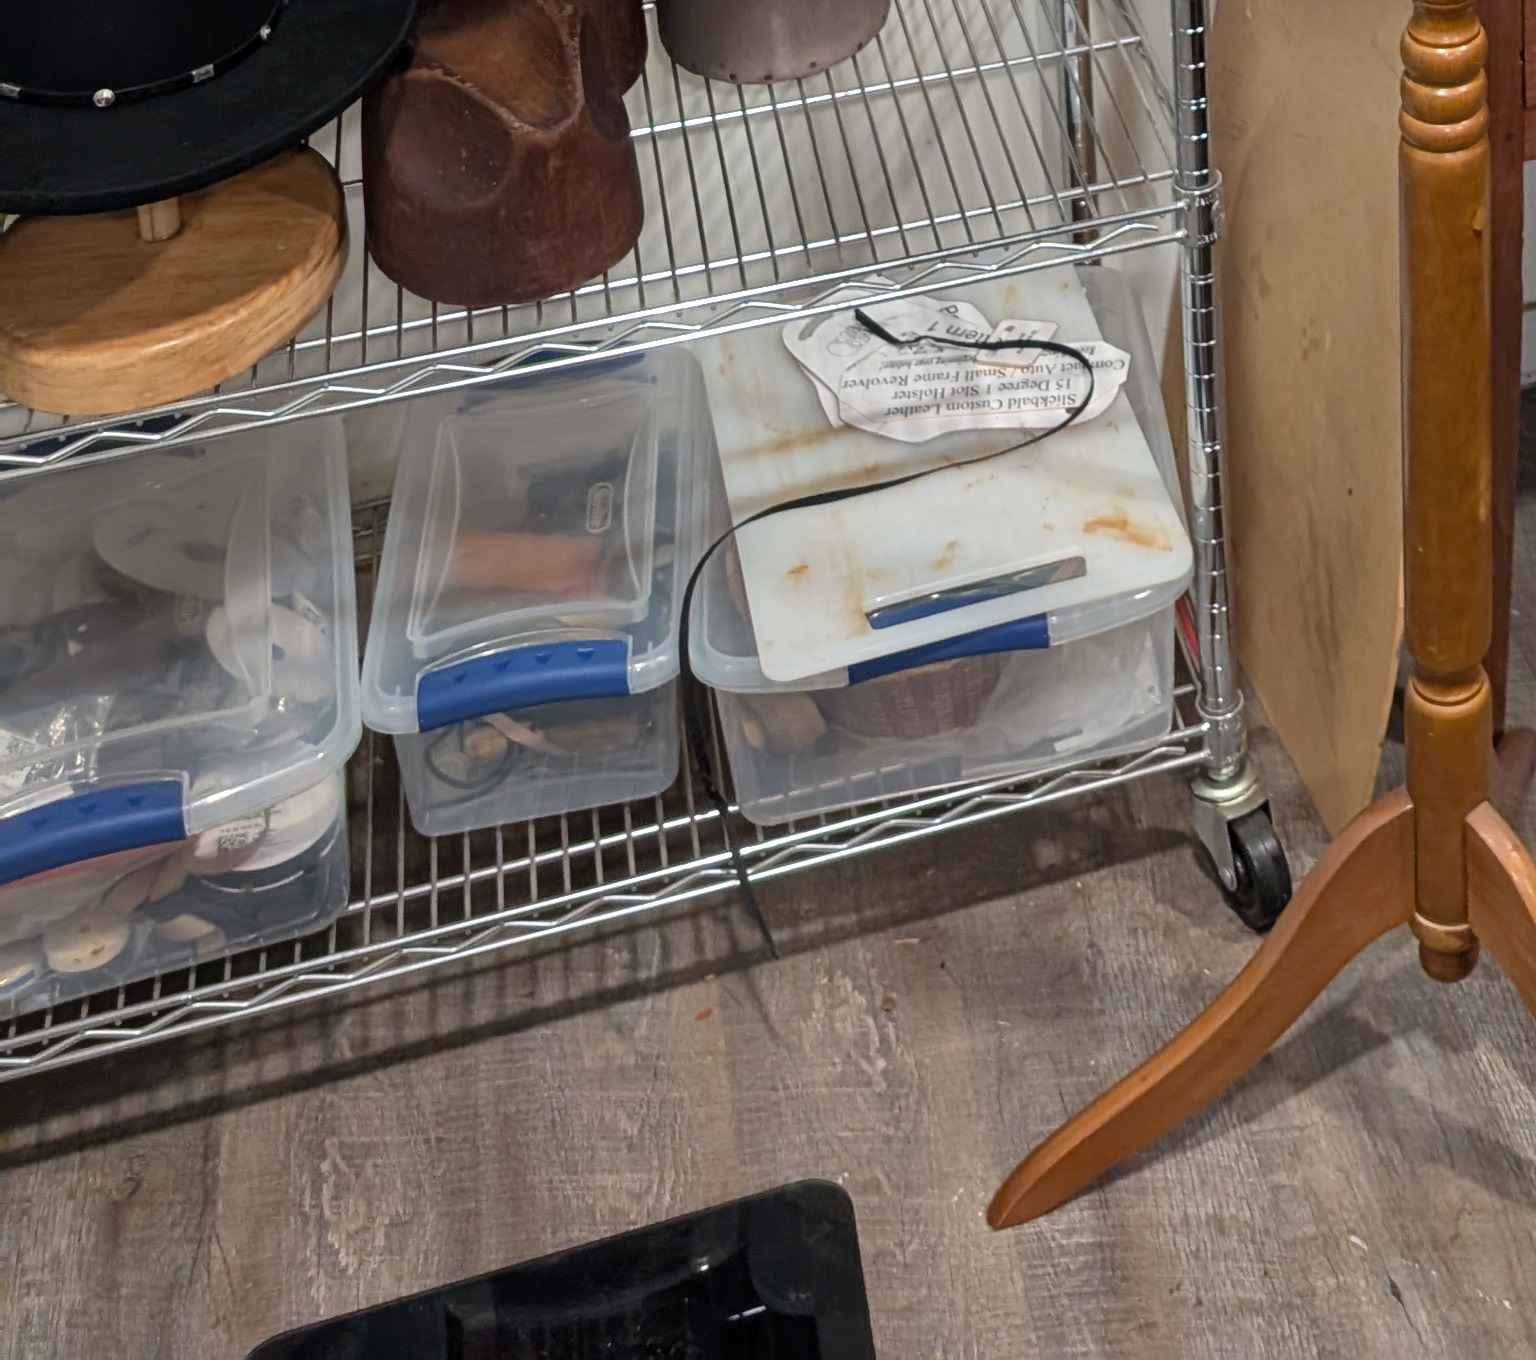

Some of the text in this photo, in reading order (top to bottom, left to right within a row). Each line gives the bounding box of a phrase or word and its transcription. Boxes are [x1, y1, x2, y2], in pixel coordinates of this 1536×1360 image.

[1020, 365, 1057, 377] Auto
[1059, 357, 1126, 372] Comact
[912, 370, 961, 385] Frame
[964, 366, 1007, 382] Small
[841, 374, 909, 391] Revolver
[998, 377, 1050, 394] Degree
[1056, 377, 1072, 390] 15
[891, 386, 945, 401] Holster
[952, 384, 981, 397] Slot
[884, 393, 1078, 418] Slickbald Custom Leather
